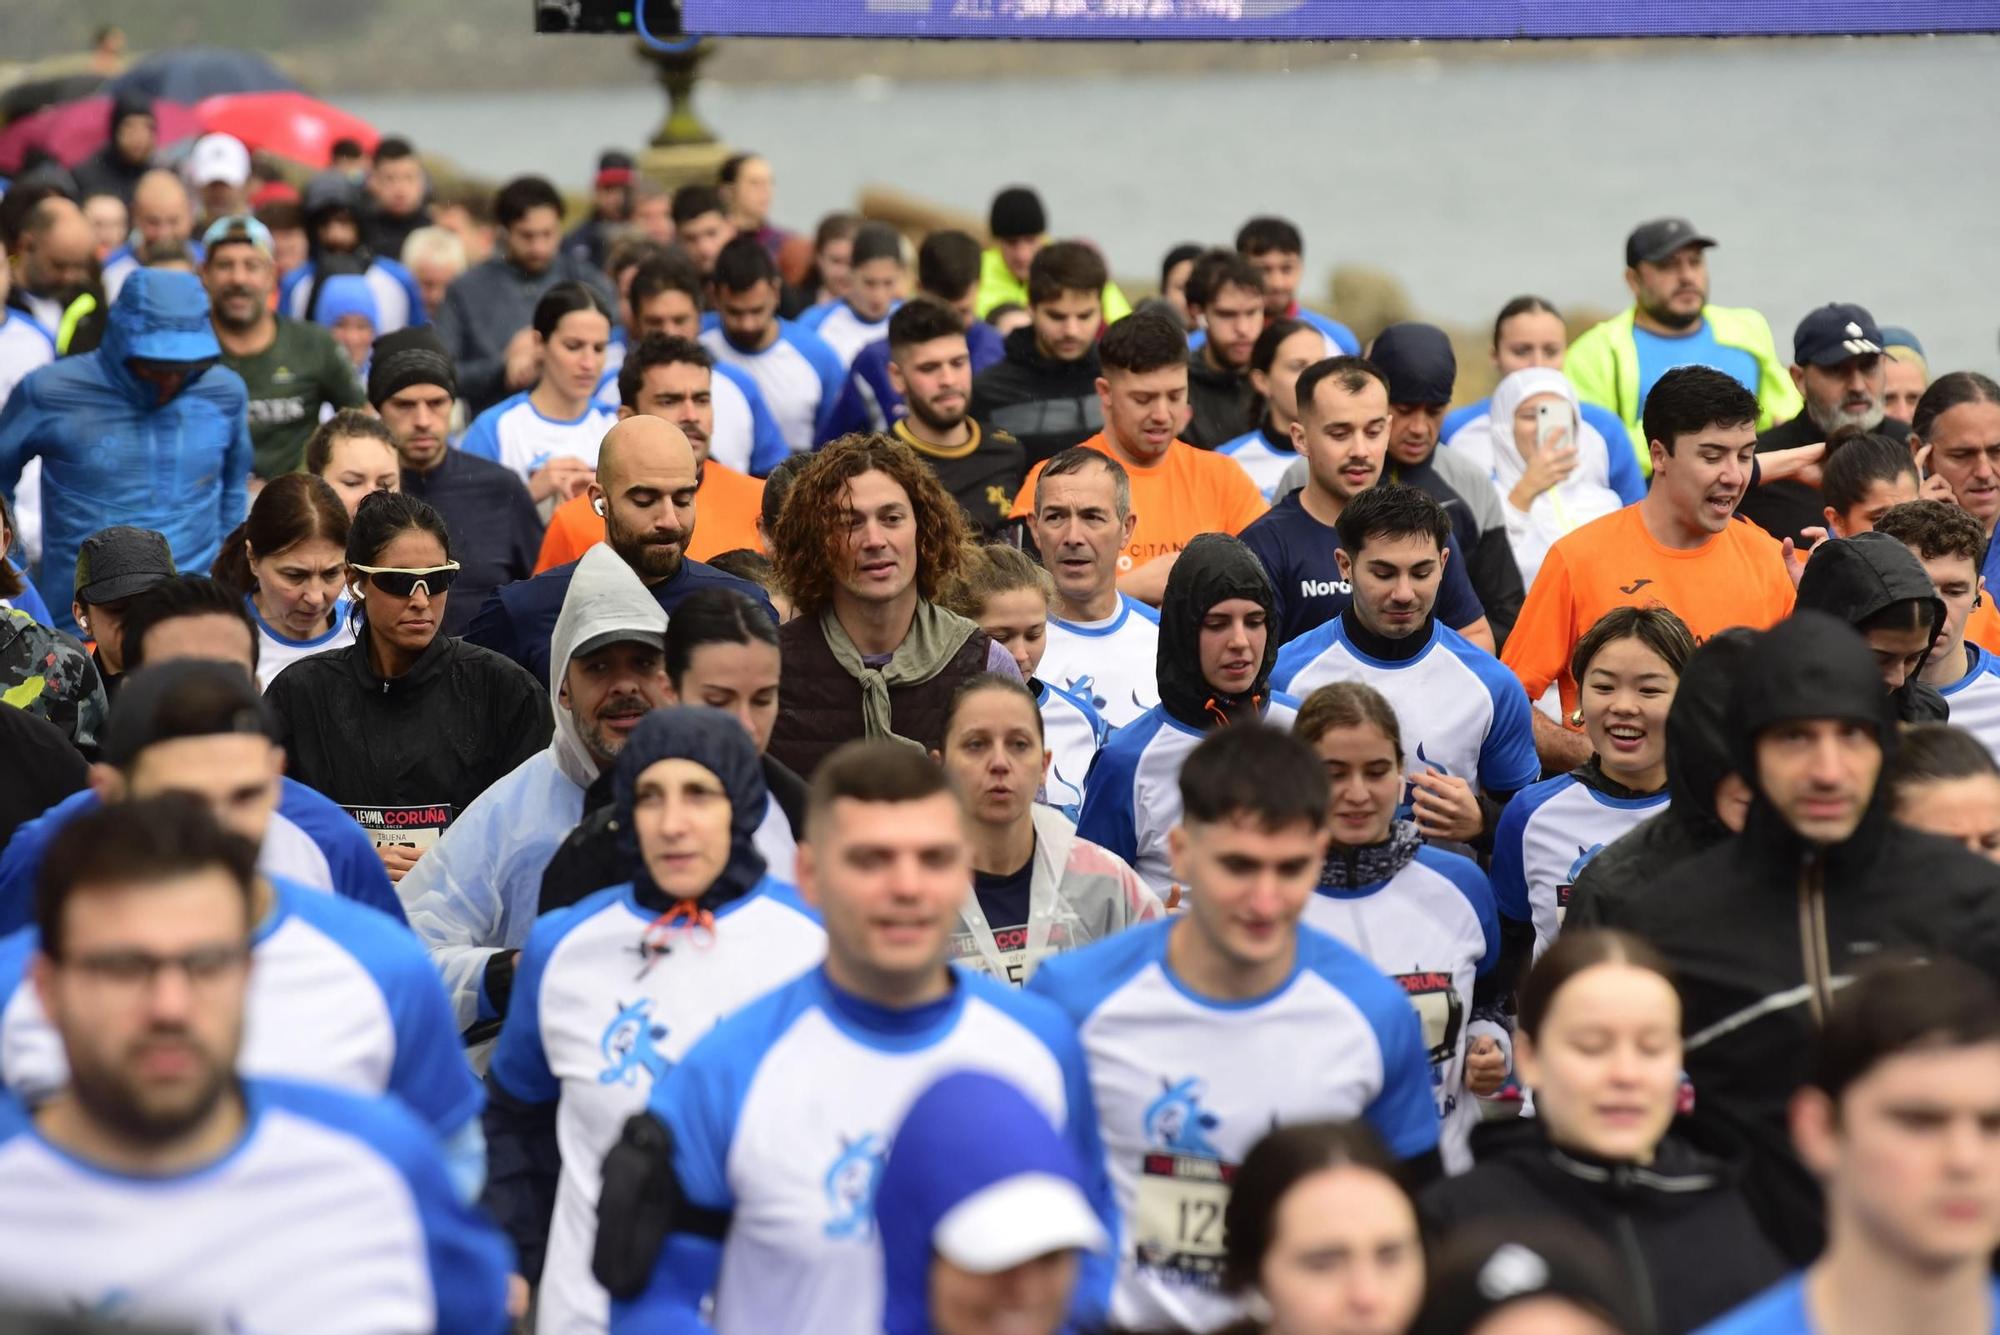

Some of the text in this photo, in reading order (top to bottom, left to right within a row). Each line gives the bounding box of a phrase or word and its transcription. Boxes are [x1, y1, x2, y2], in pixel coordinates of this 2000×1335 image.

[356, 807, 447, 825] LEYMA CORUÑA
[1177, 1199, 1225, 1244] 12
